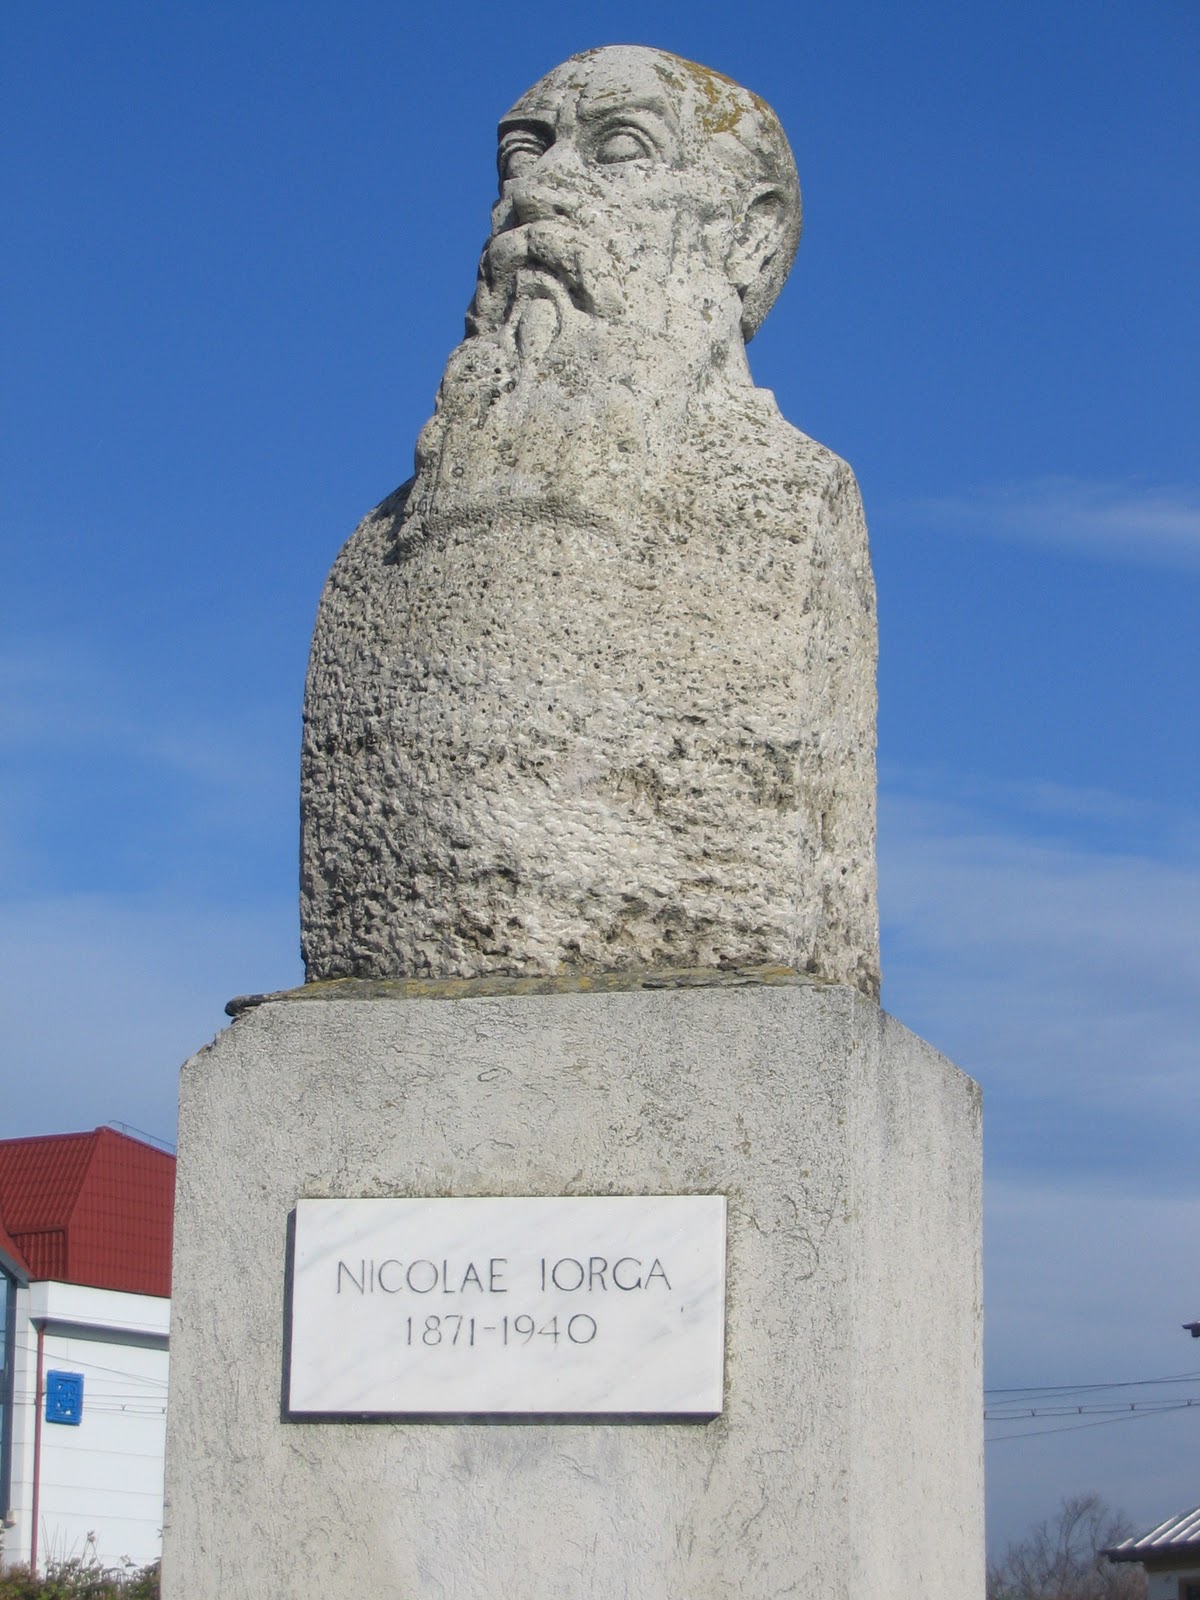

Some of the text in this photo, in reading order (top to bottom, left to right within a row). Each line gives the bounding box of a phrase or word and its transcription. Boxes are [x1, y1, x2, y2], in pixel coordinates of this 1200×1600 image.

[336, 1256, 672, 1295] NICOLAE IORGA
[405, 1313, 598, 1347] 1871-1940
